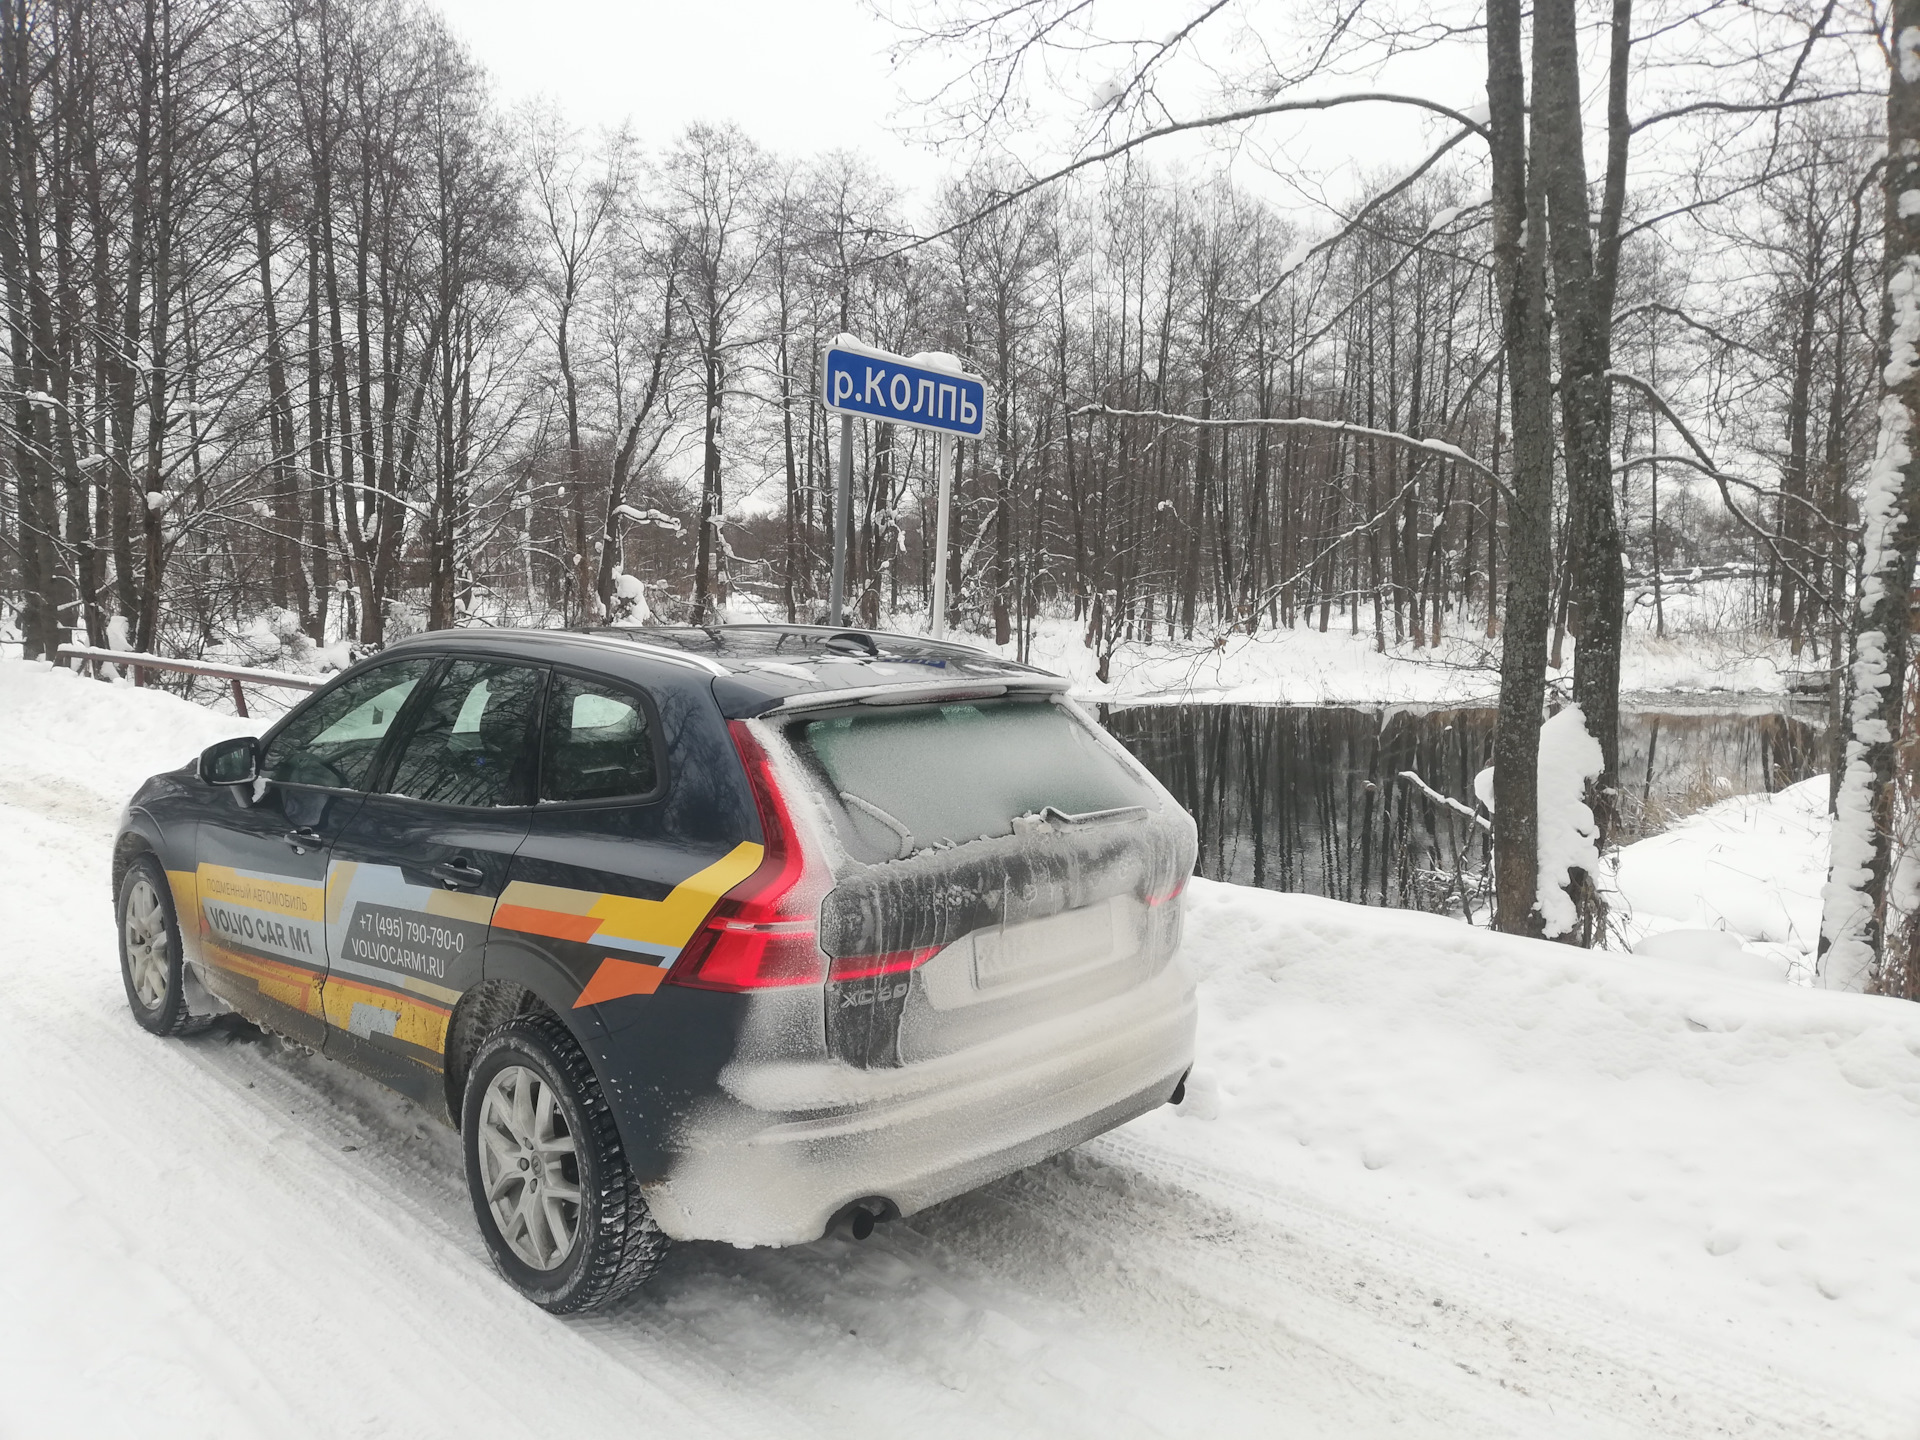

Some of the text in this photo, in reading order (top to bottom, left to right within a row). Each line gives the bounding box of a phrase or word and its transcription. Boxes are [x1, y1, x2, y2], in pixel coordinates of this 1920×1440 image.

[834, 367, 977, 425] р.КОЛПЬ
[207, 878, 307, 911] ПОДМЕННЫЙ АВТОМОБИЛЬ
[210, 906, 313, 954] VOLVO CAR M1
[360, 912, 464, 953] +7 (495) 790-790-0
[351, 938, 444, 978] VOLVOCARM1.RU
